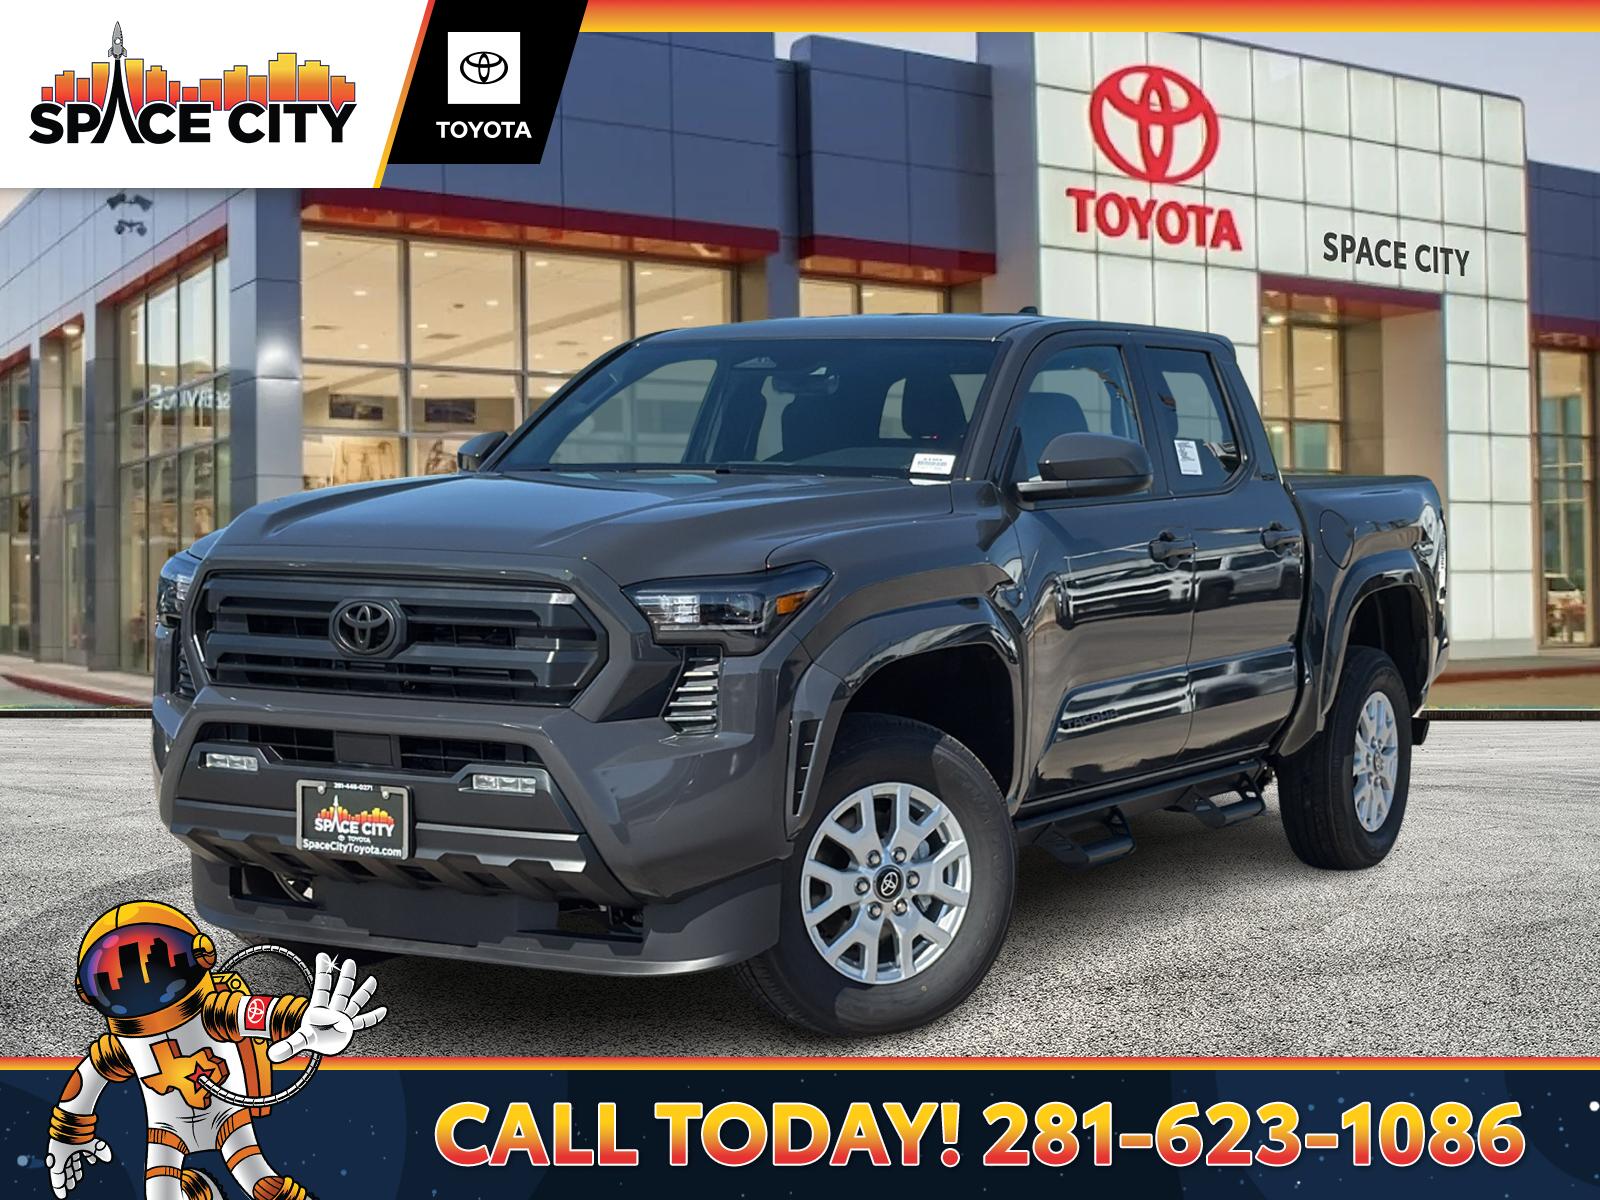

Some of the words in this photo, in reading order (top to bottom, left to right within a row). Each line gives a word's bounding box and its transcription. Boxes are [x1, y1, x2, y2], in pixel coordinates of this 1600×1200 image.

[1066, 187, 1243, 251] TOYOTA
[1323, 232, 1407, 270] SPACE
[1414, 244, 1470, 277] CITY
[1063, 710, 1120, 728] TACOMA
[314, 807, 359, 835] SPACE
[361, 821, 395, 837] CITY
[302, 838, 402, 857] SpaceCityToyota.com
[347, 835, 371, 843] TOYOTA
